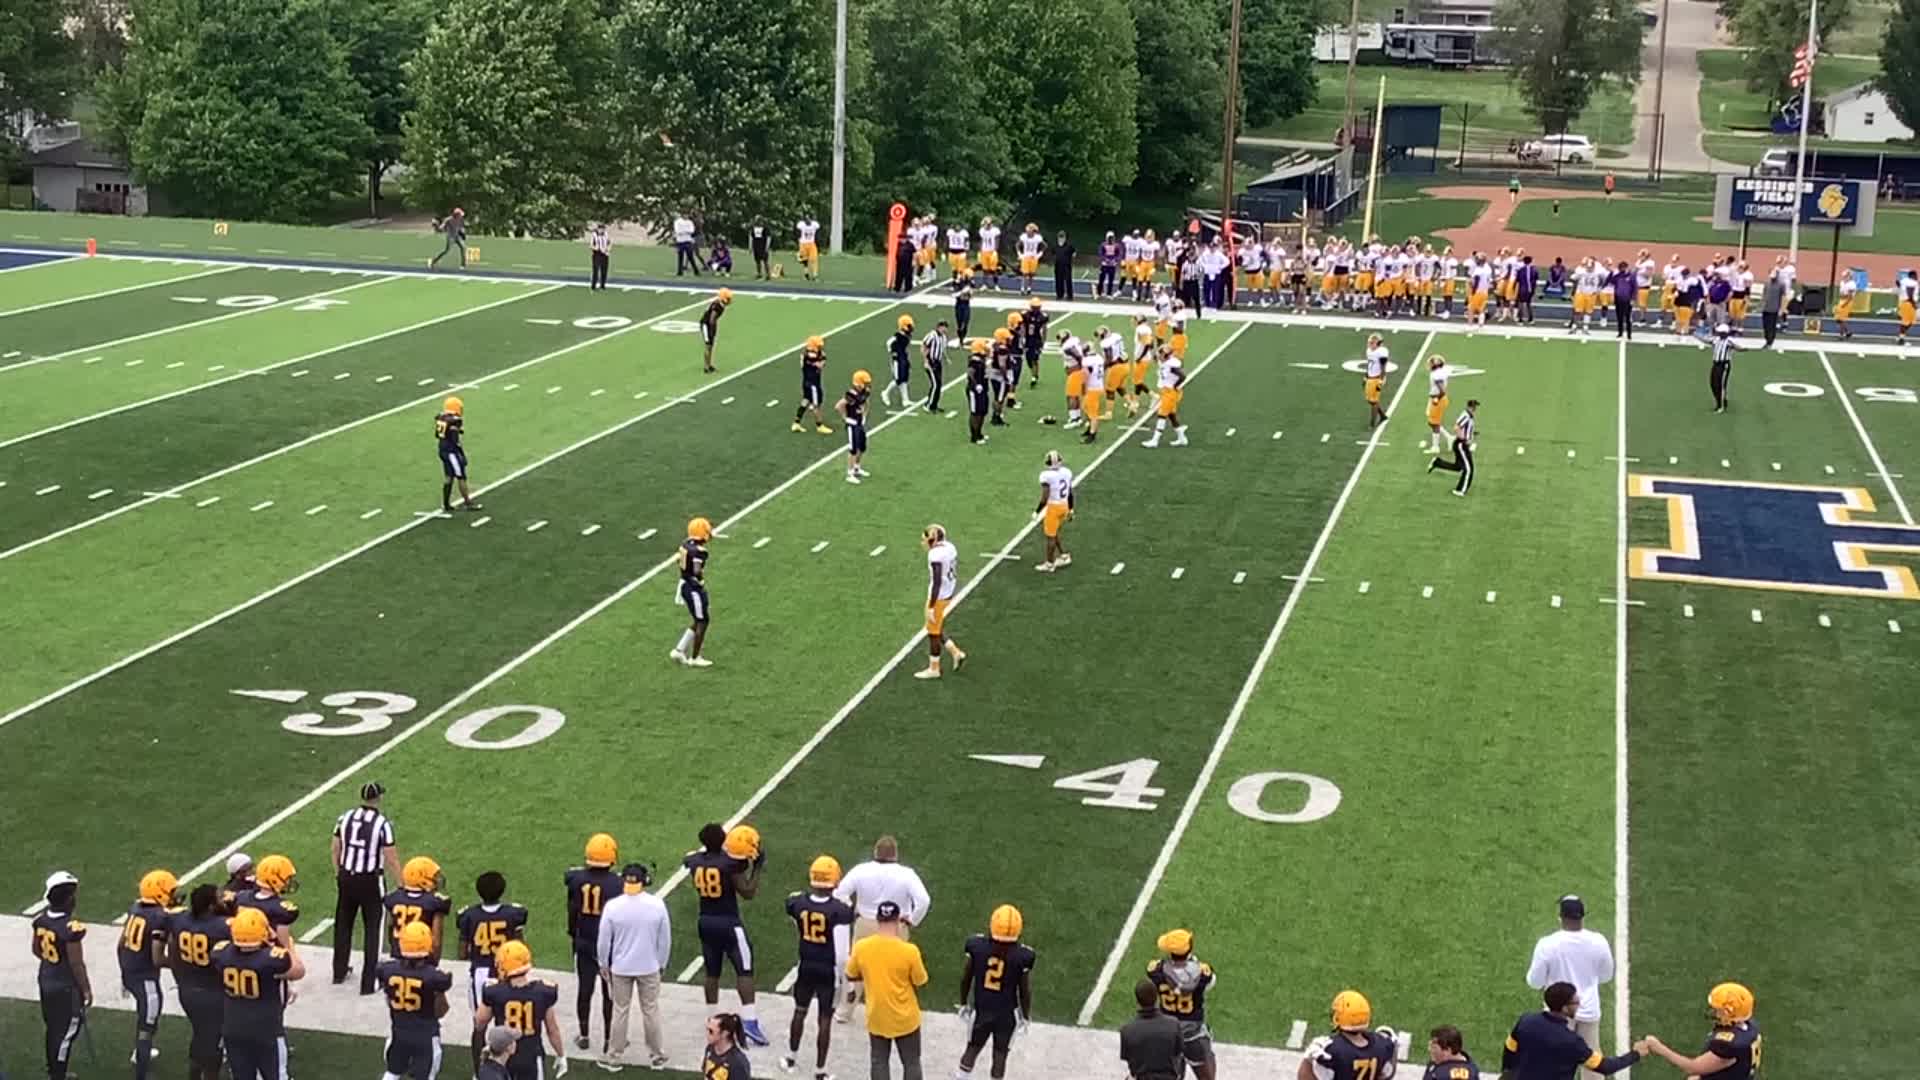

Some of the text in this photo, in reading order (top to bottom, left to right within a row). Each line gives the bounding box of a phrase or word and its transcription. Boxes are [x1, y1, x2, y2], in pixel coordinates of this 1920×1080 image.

[1735, 179, 1814, 194] KESSINGR
[1753, 191, 1794, 203] FIELD
[281, 690, 567, 750] 30
[1053, 757, 1342, 824] 40
[349, 821, 366, 847] L
[581, 883, 600, 915] 11
[694, 866, 722, 898] 48
[474, 921, 507, 955] 45
[800, 909, 826, 944] 12
[179, 931, 209, 966] 98
[223, 967, 259, 999] 90
[983, 956, 1005, 990] 2
[388, 975, 422, 1012] 35
[504, 1000, 535, 1035] 81
